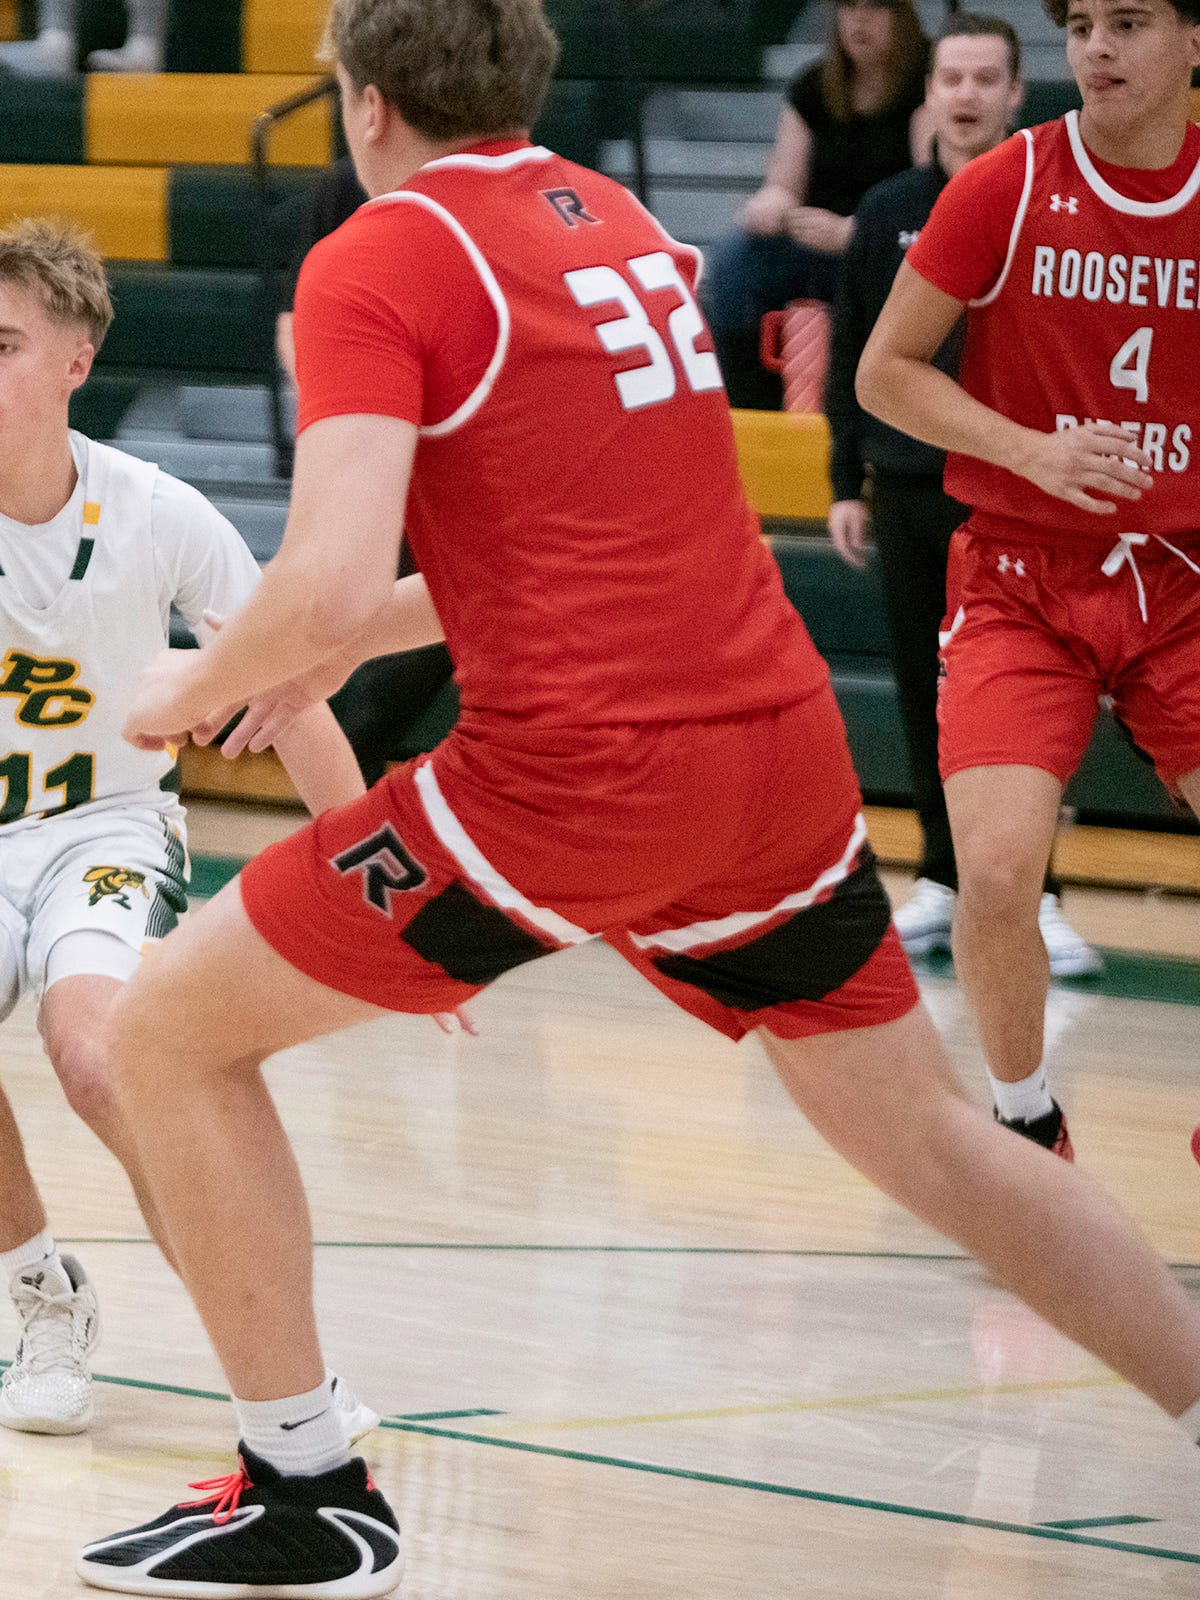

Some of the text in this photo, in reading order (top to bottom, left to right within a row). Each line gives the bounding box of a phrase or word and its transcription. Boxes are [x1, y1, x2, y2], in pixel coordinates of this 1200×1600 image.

[538, 186, 604, 229] R
[1031, 244, 1200, 310] ROOSEVE
[563, 250, 726, 411] 32
[1108, 326, 1154, 403] 4
[328, 819, 431, 920] R
